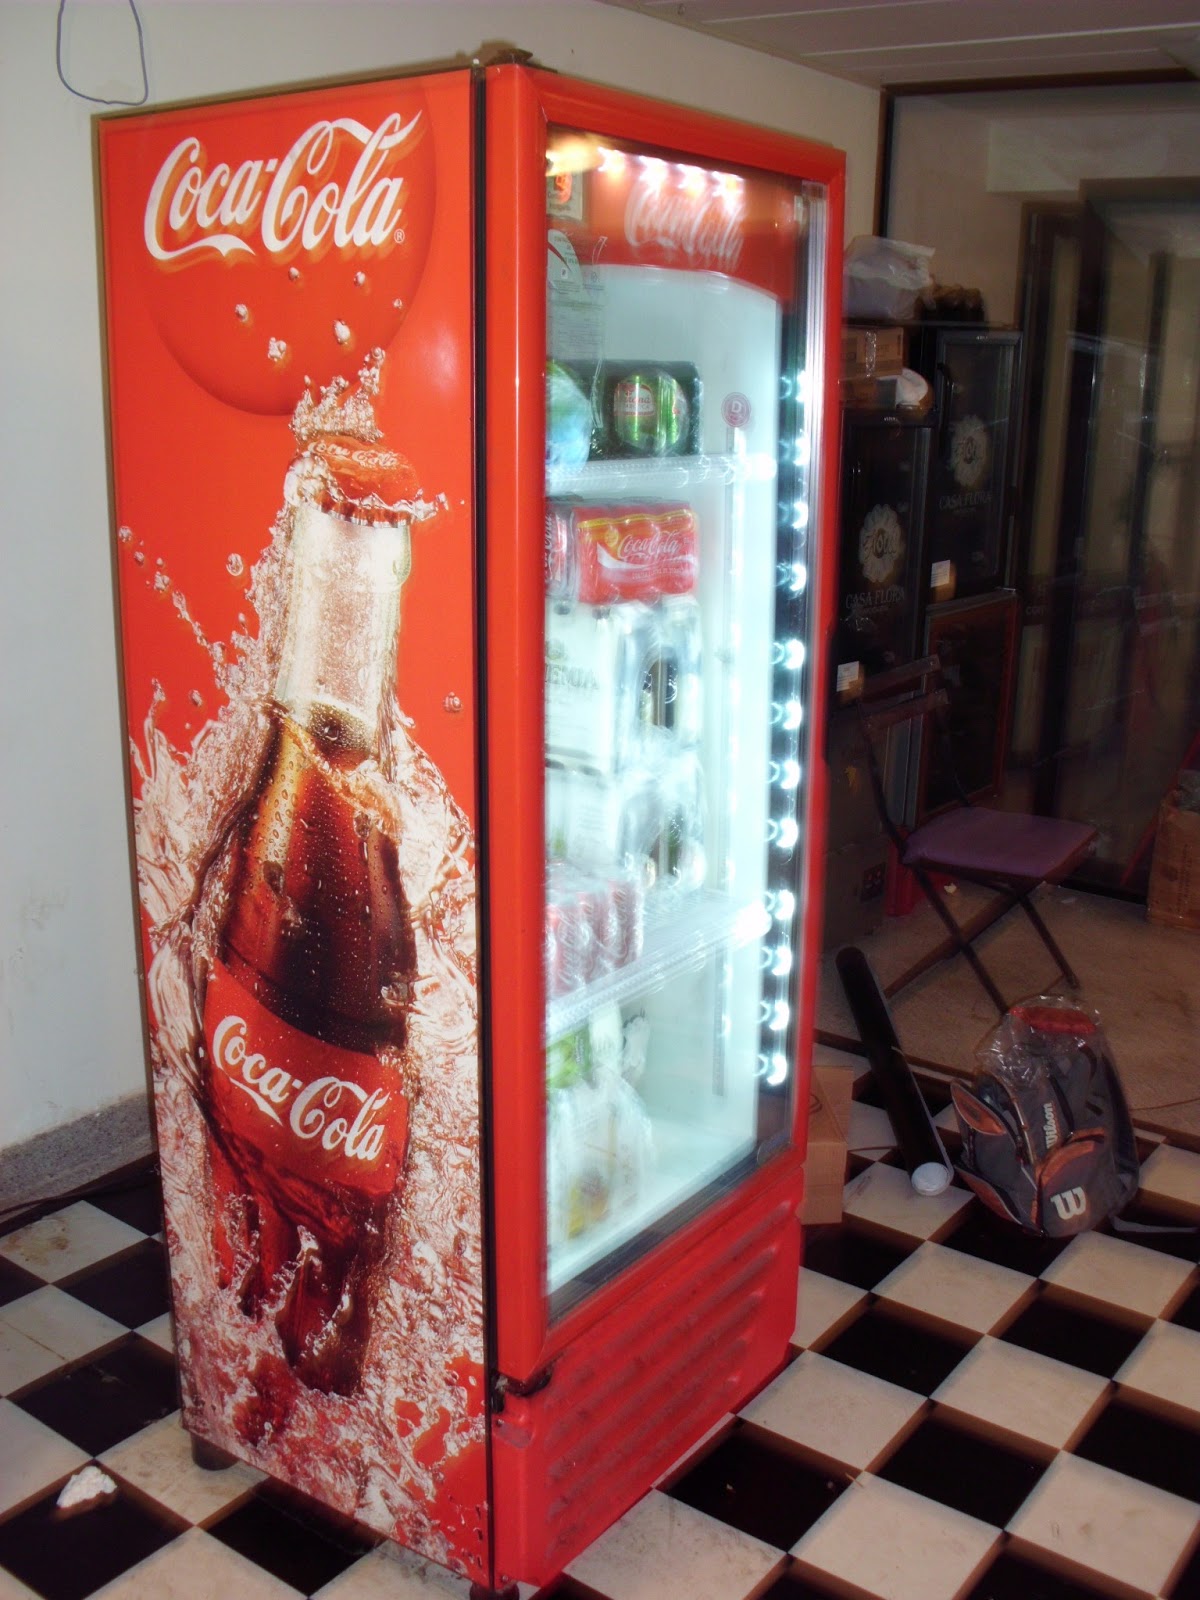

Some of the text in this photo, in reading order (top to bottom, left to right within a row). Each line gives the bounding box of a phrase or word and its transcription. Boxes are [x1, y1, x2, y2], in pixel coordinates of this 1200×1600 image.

[144, 110, 422, 260] Coca-Cola
[845, 585, 905, 609] CASA FLORA
[212, 1015, 390, 1160] Coca-Cola
[1043, 1102, 1059, 1149] Wilson
